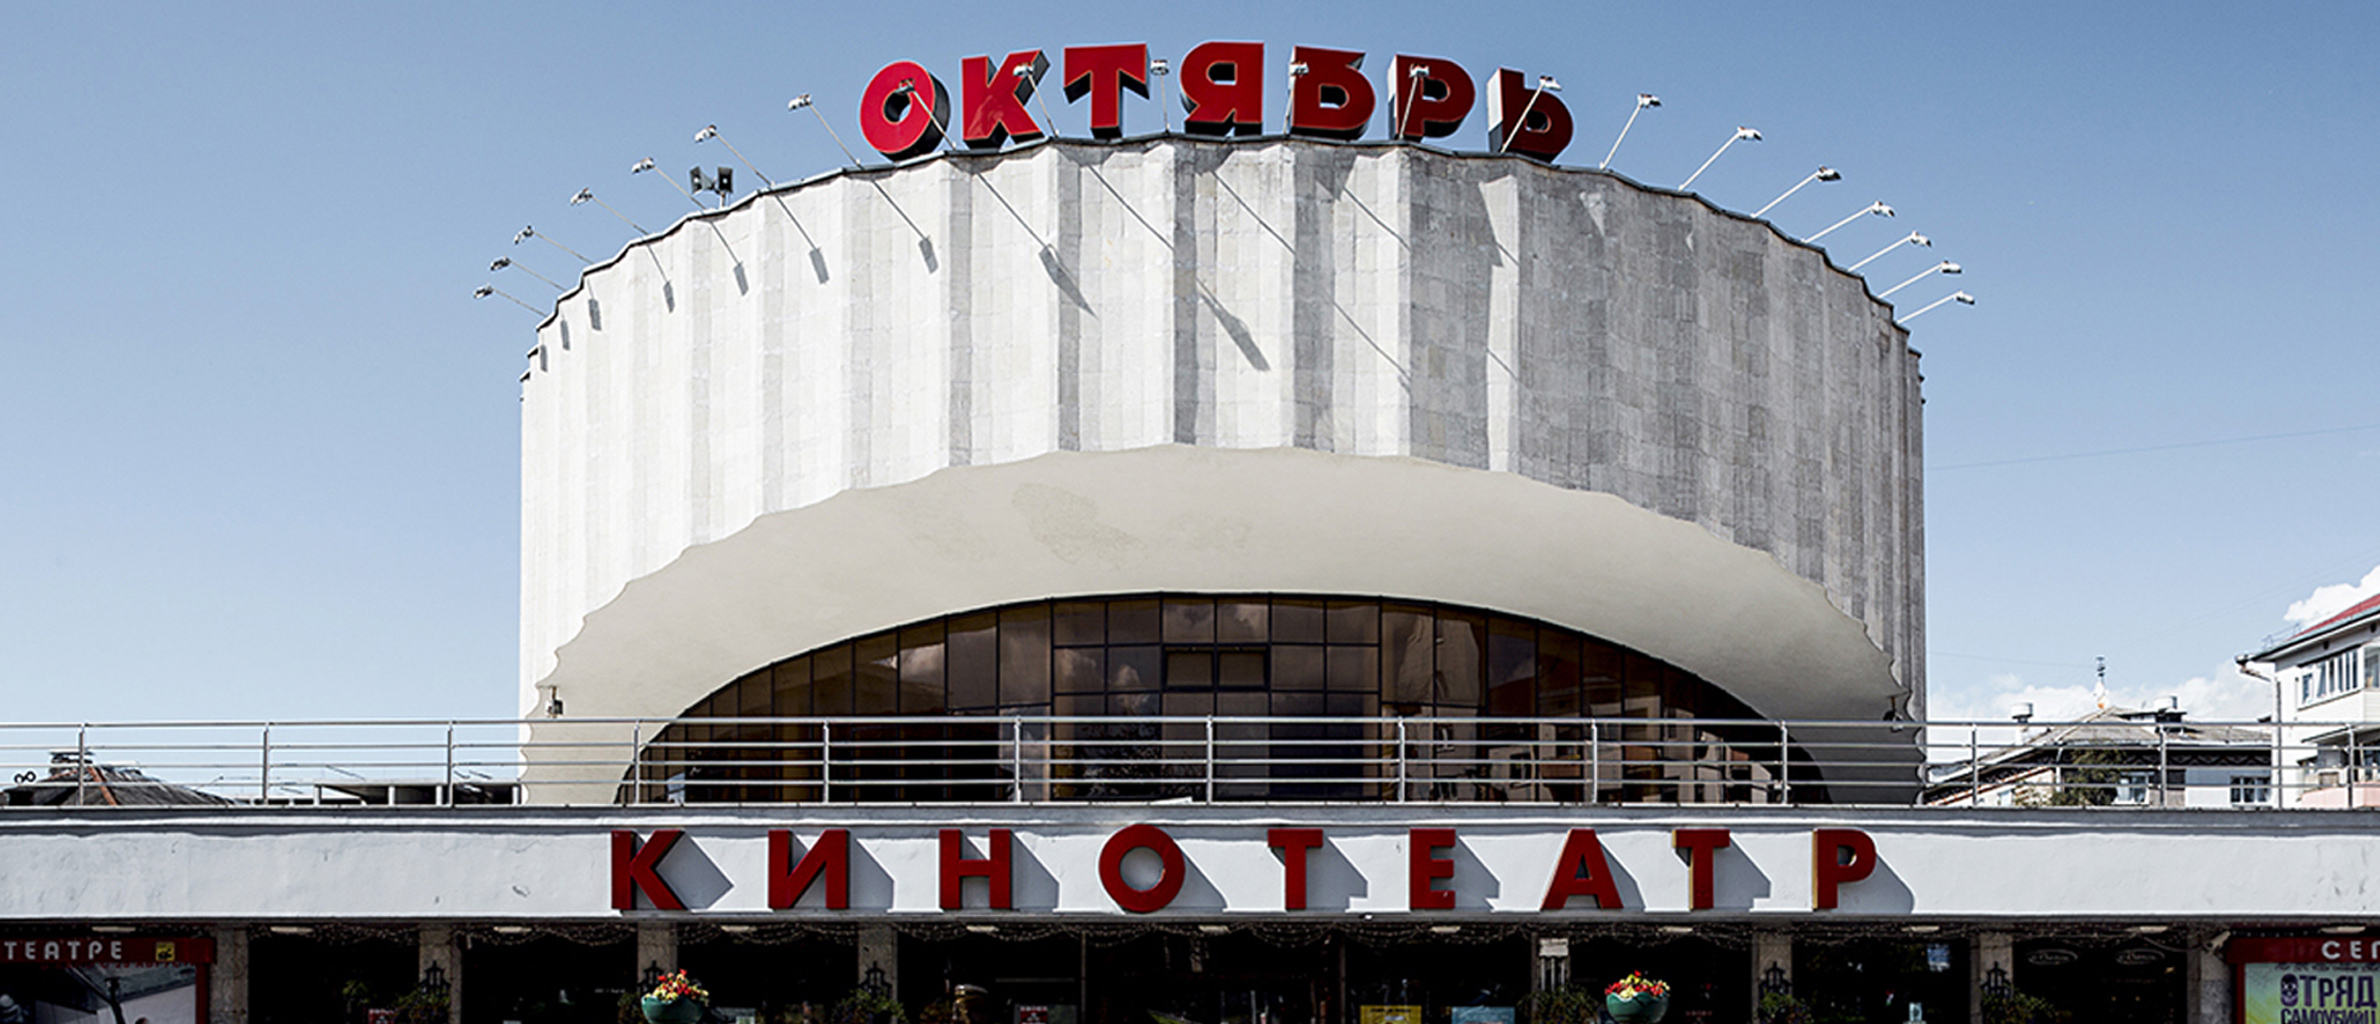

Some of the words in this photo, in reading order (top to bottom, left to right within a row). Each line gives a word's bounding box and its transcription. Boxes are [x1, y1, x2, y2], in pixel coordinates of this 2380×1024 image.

[859, 41, 1575, 163] ОКТЯБРЬ
[611, 823, 1878, 913] КИНОТЕАТР
[2, 939, 123, 961] ТЕАТРЕ
[2280, 973, 2377, 1008] ОТРЯД
